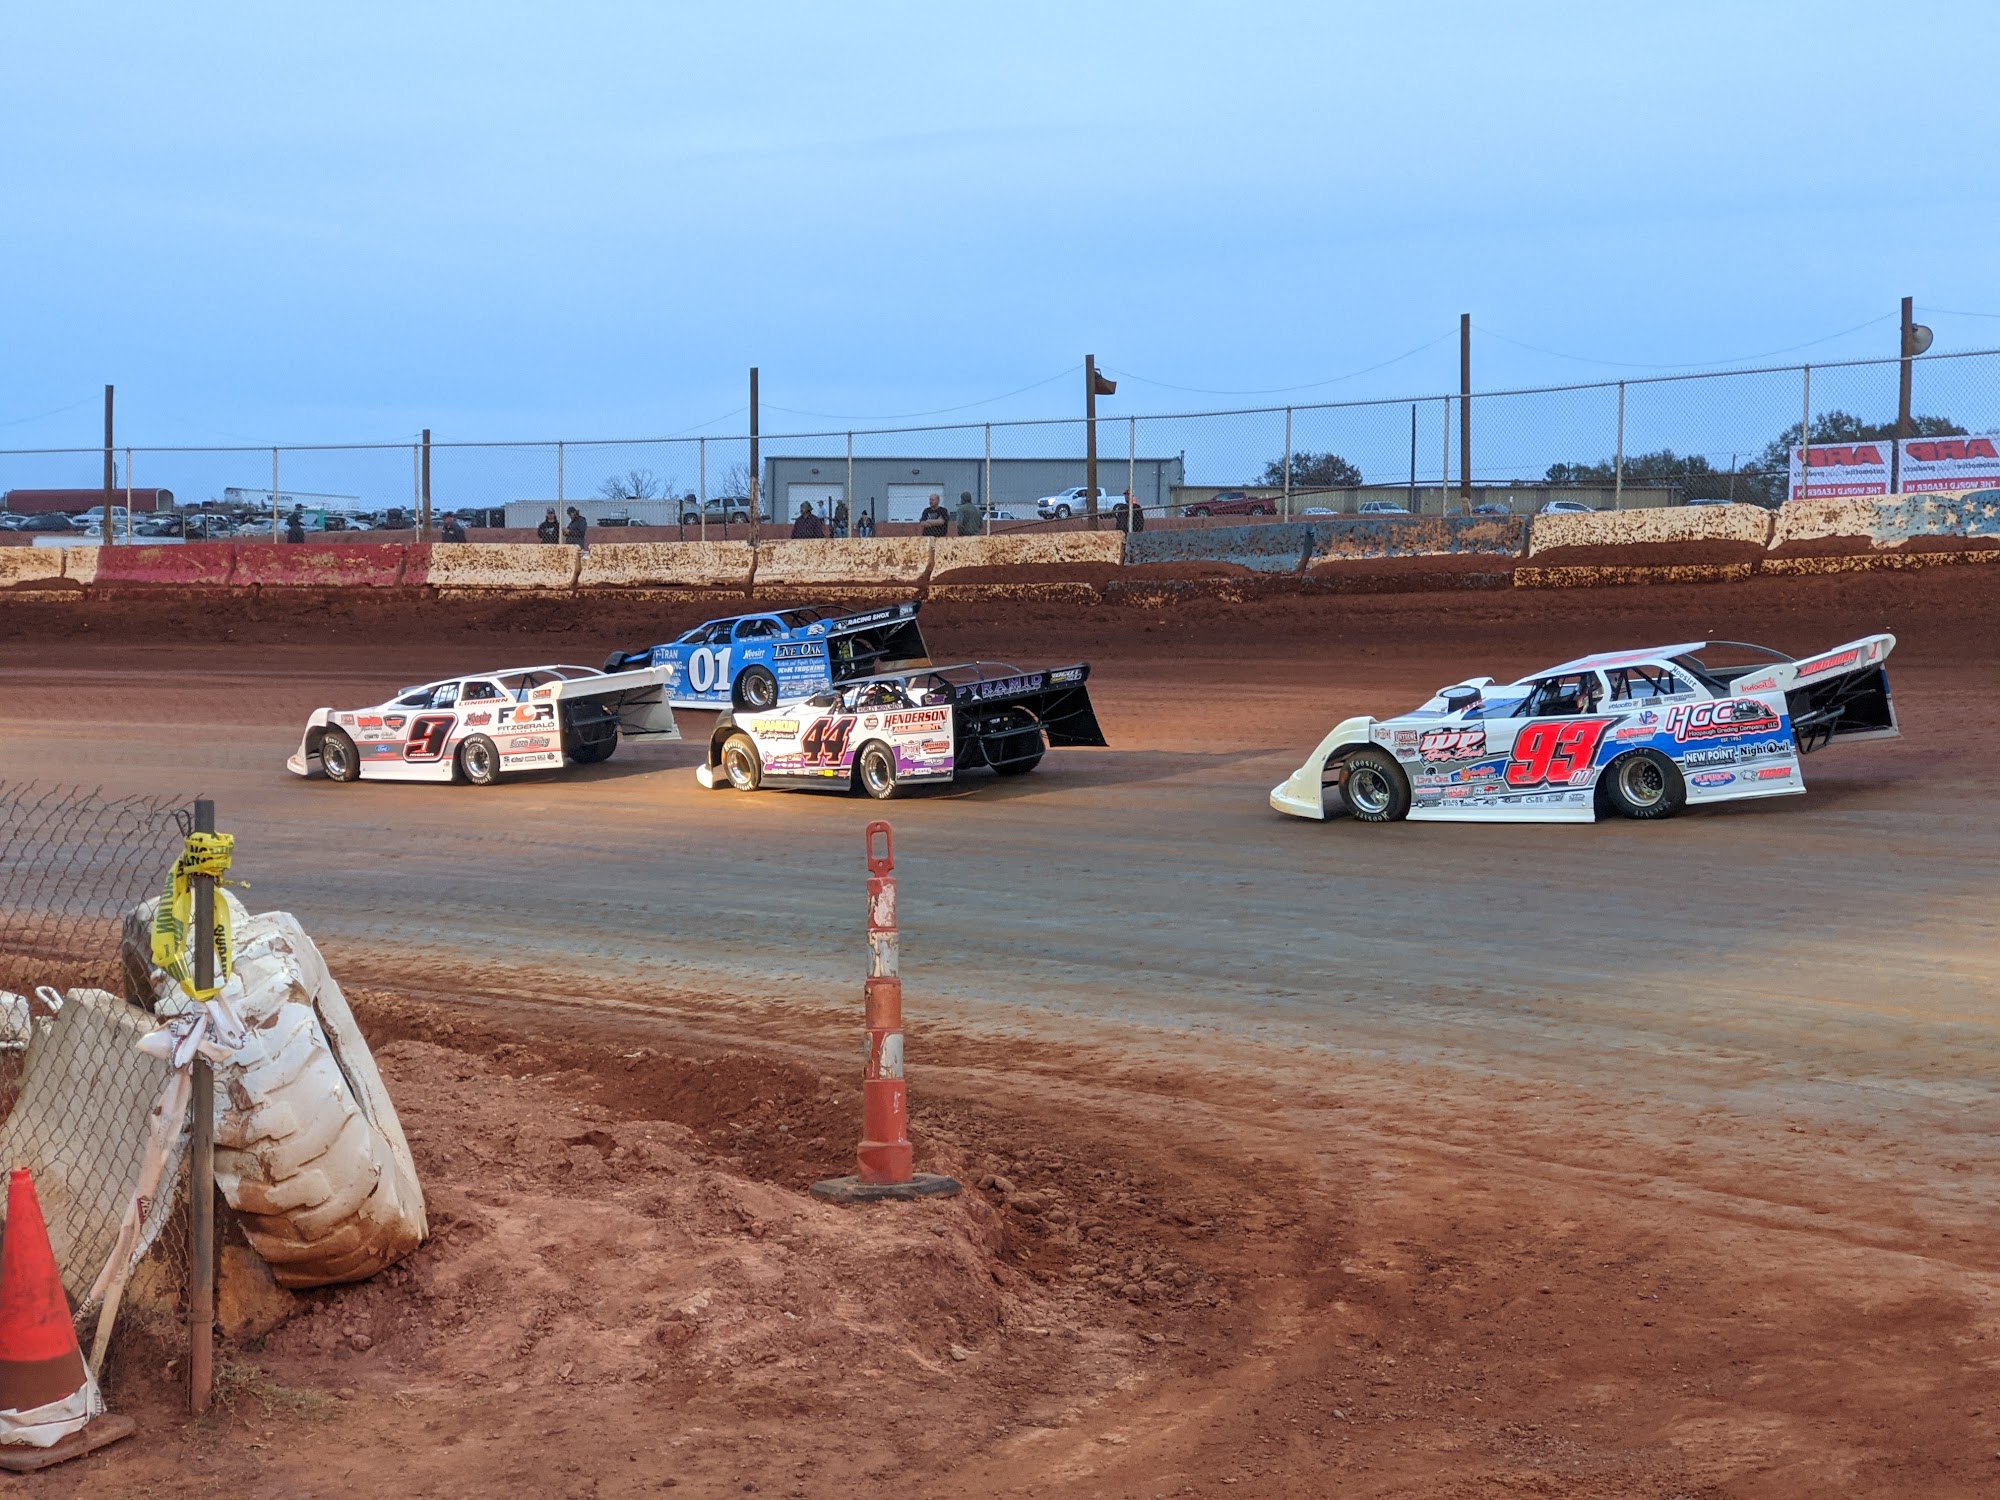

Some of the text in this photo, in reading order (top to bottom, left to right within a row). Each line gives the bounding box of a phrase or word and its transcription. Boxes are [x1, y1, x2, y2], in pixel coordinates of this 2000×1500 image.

[847, 614, 872, 626] RACING
[872, 611, 890, 621] SHOX
[689, 647, 732, 692] 01
[1670, 666, 1698, 687] Hoosier
[955, 674, 1043, 698] PYRAMID
[458, 698, 508, 707] LONGHORN
[497, 721, 555, 732] FITZGERALD
[751, 719, 800, 734] FRANKLIN
[884, 710, 947, 729] HENDERSON
[1716, 725, 1739, 735] Grading
[1767, 721, 1778, 729] LLC
[404, 713, 458, 762] 9
[801, 716, 858, 767] 44
[1420, 731, 1486, 752] WP
[1506, 719, 1615, 785] 93
[1686, 752, 1706, 763] NEW
[1708, 748, 1734, 761] POINT
[1349, 760, 1383, 771] Hoosier
[1694, 770, 1733, 783] SUPERIOR
